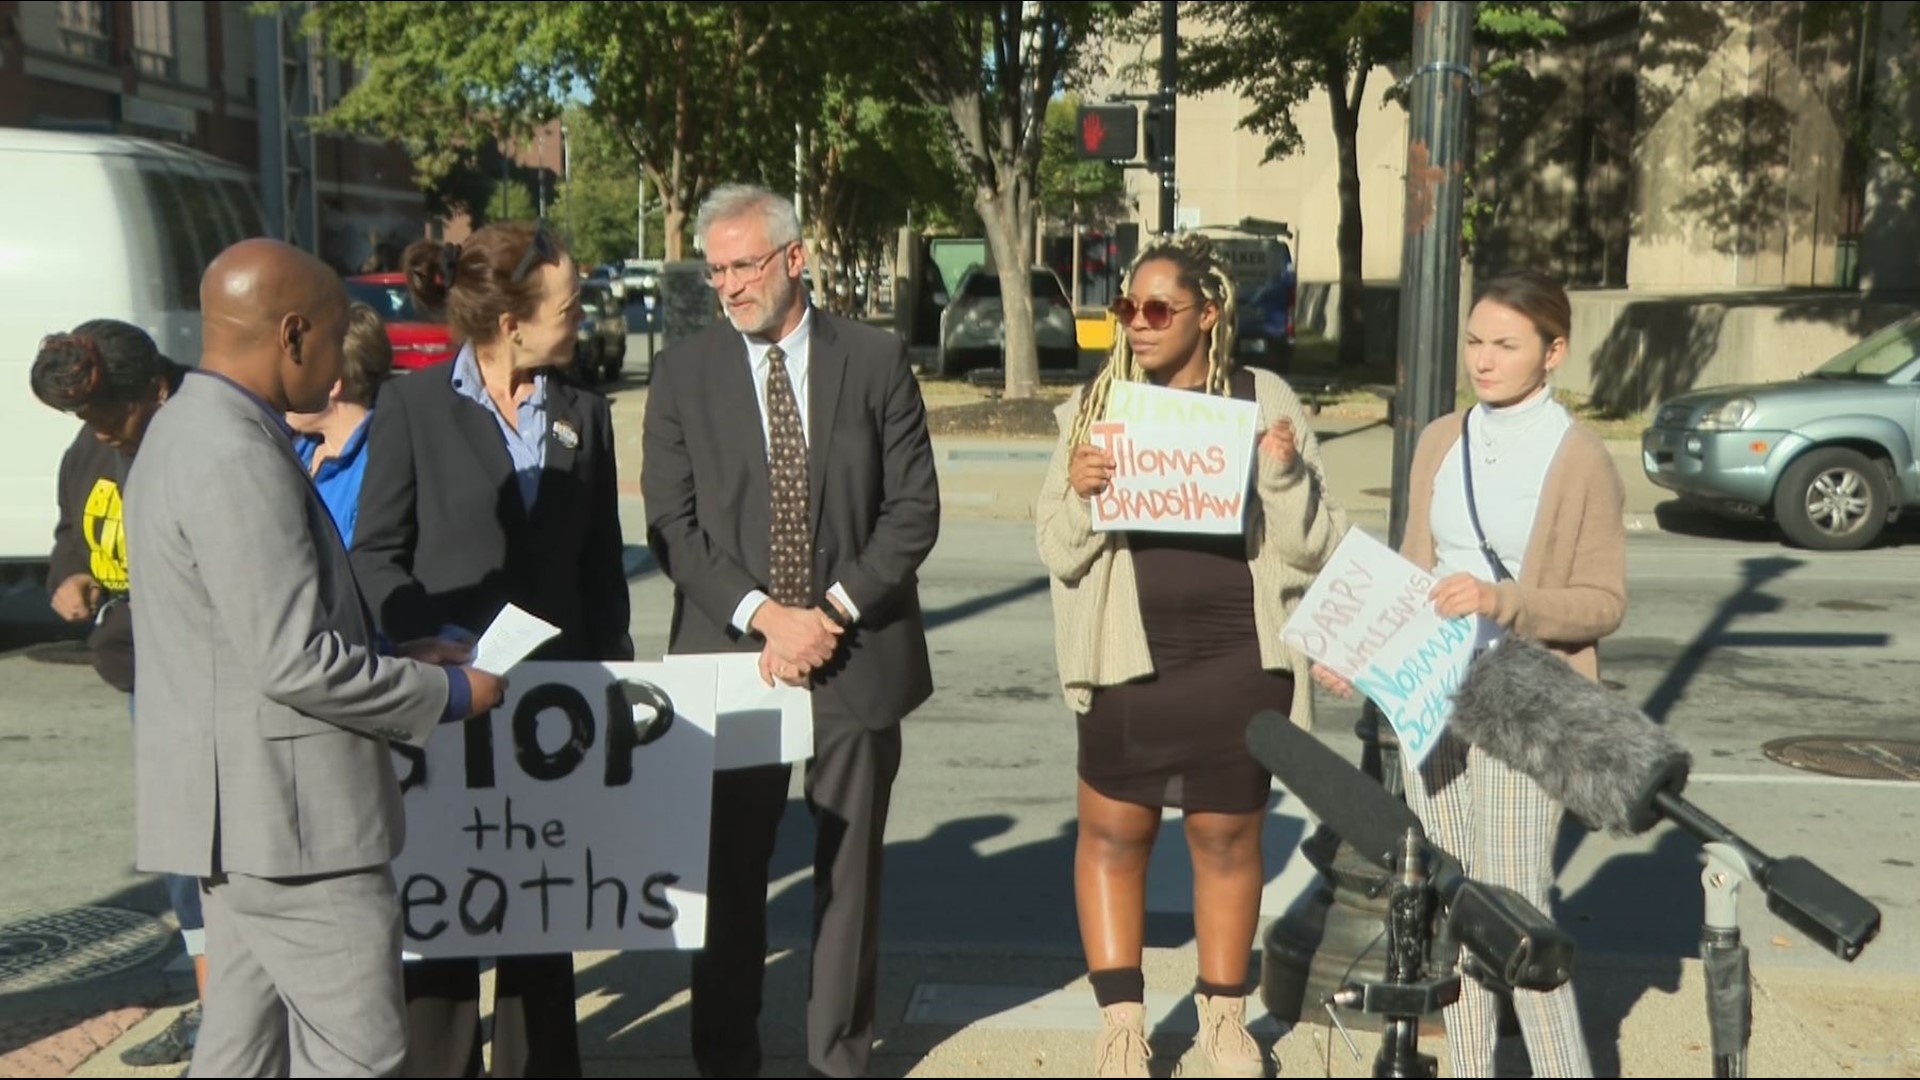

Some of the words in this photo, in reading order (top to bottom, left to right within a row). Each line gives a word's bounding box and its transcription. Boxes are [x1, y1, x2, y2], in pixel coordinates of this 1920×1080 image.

[1091, 422, 1227, 478] THOMAS
[1097, 477, 1242, 523] BRADSHAW
[1287, 558, 1374, 658] BARRY
[1354, 615, 1472, 717] NORMAN
[461, 794, 566, 850] the
[401, 846, 681, 942] eaths
